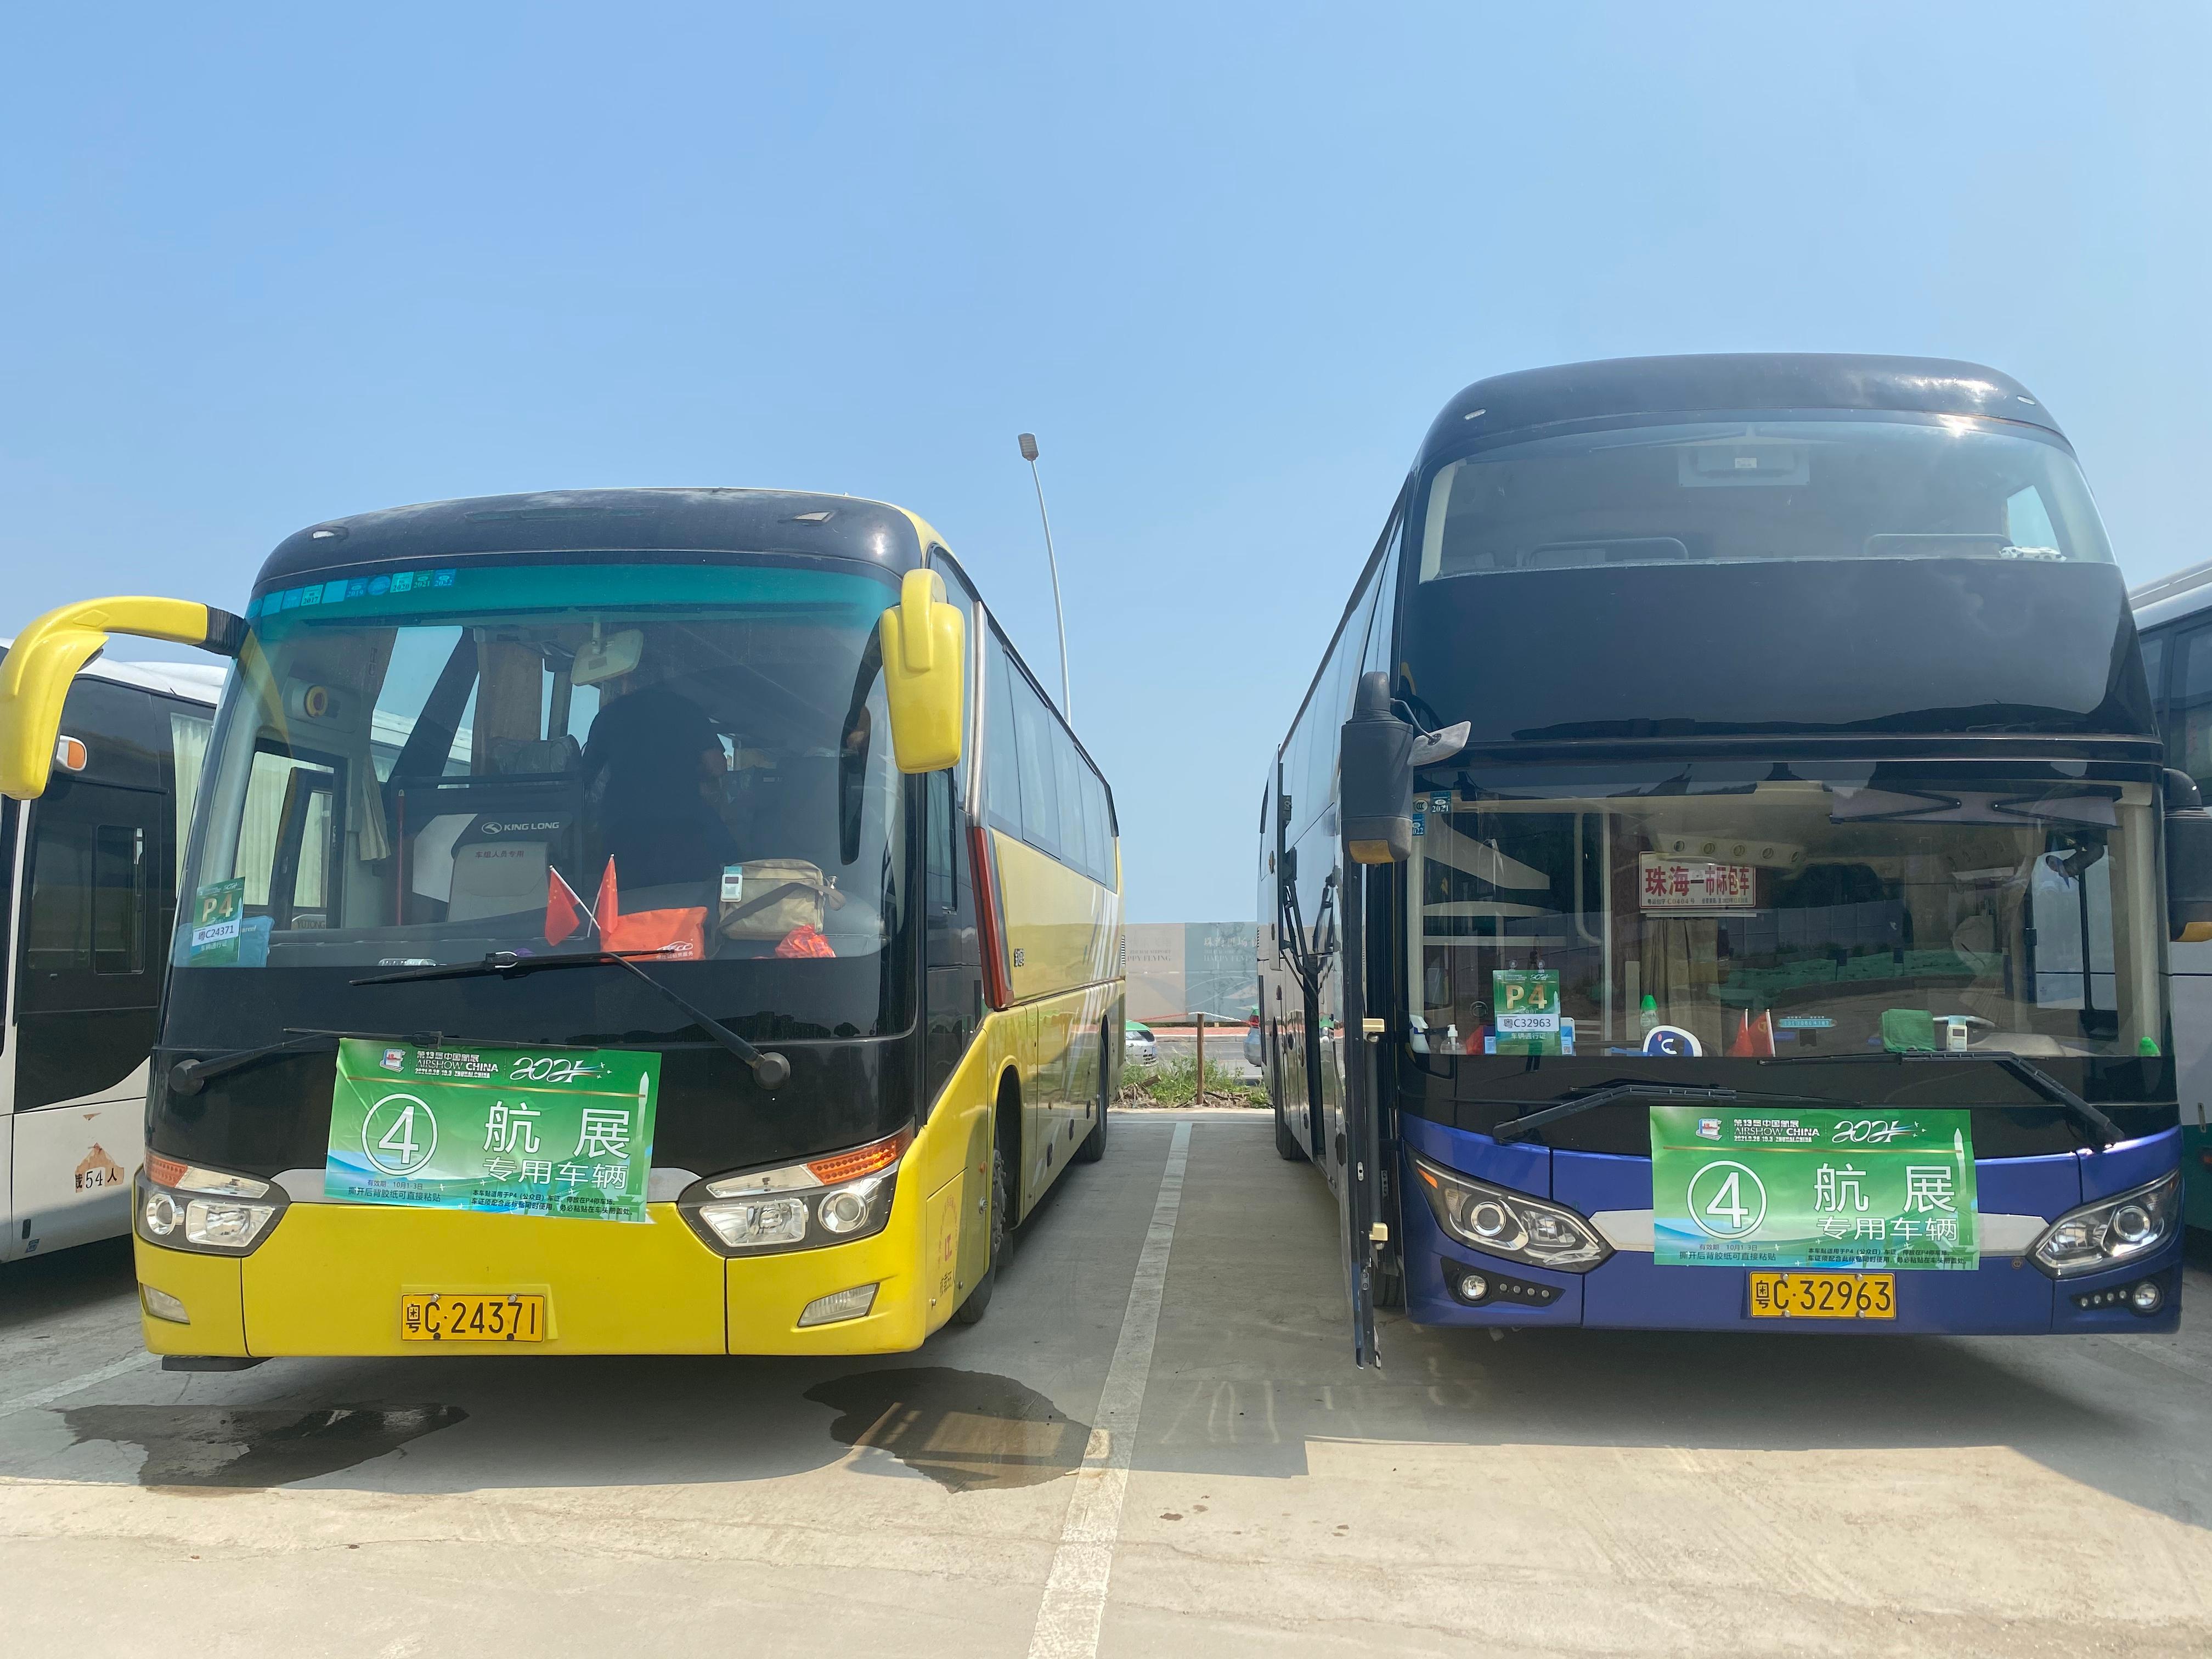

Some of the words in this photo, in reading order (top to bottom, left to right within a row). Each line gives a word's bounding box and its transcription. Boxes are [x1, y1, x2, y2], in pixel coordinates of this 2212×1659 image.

[475, 850, 524, 859] 车组人员专用
[198, 925, 234, 941] 粤C24371
[1505, 984, 1548, 1009] P4
[1504, 1018, 1551, 1029] 粤C32963
[416, 1059, 463, 1070] AIRSHOW
[466, 1062, 499, 1072] CHINA
[510, 1057, 582, 1083] 2021
[1734, 1127, 1782, 1136] AIRSHOW
[1786, 1128, 1820, 1136] CHINA
[1832, 1120, 1897, 1143] 2021
[482, 1156, 628, 1190] 专用车辆
[348, 1187, 441, 1202] 撕开后背胶纸可直接粘贴
[1816, 1216, 1958, 1242] 专用车辆
